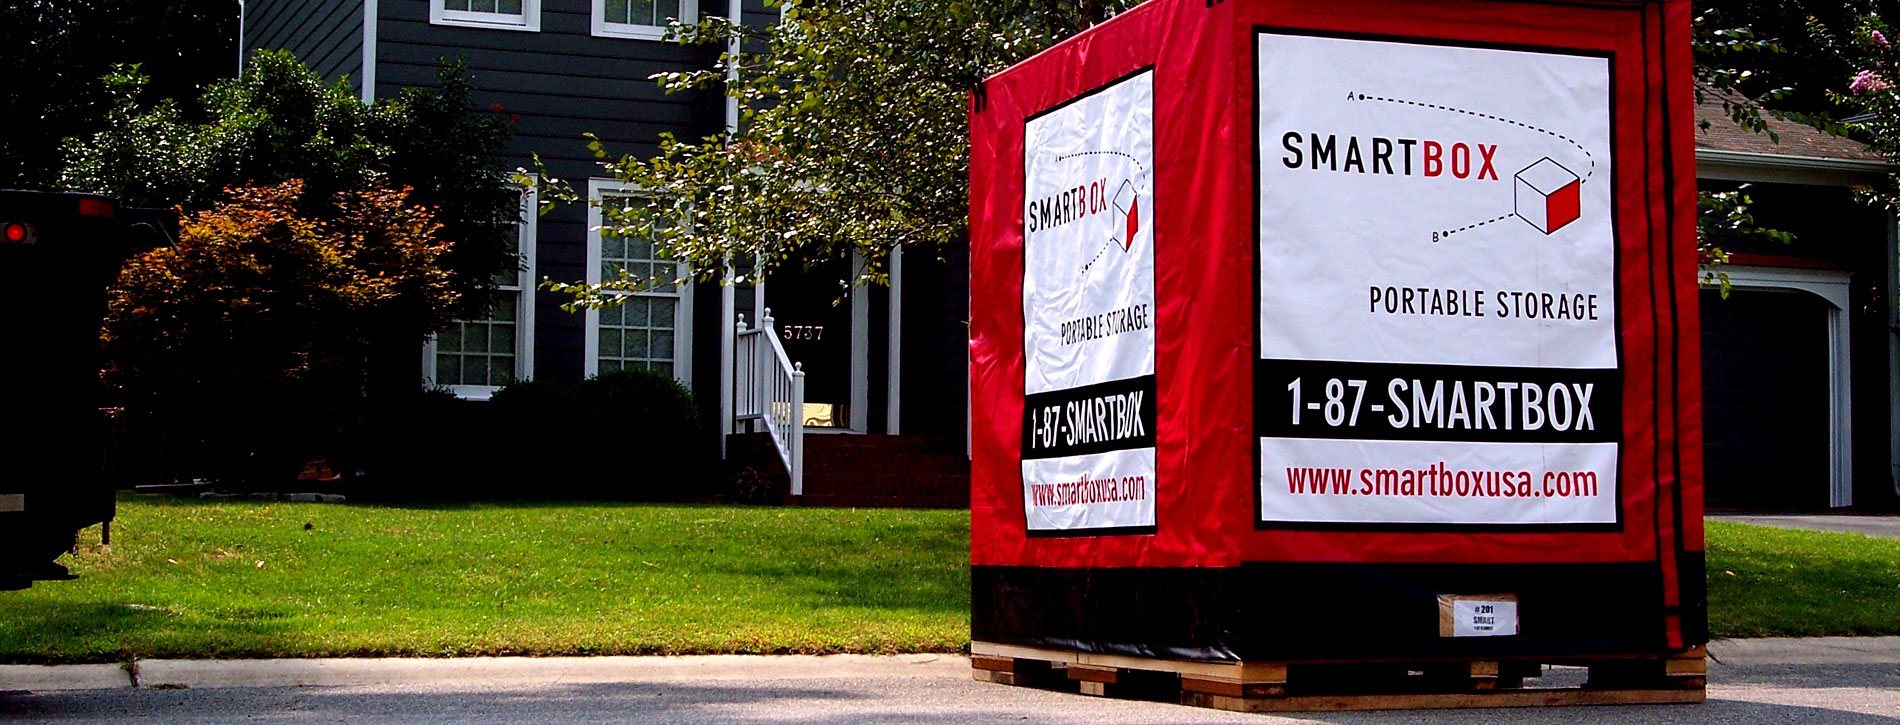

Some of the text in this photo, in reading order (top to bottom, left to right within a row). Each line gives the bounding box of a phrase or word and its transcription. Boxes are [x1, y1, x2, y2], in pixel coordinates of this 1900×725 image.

[1347, 91, 1355, 101] A
[1281, 131, 1499, 181] SMARTBOX
[1029, 177, 1107, 233] SMARTBOX
[1432, 231, 1440, 243] B
[1369, 286, 1599, 321] PORTABLE STORAGE
[784, 325, 824, 340] 5737
[1061, 303, 1149, 346] PORTABLE STORAGE
[1032, 390, 1145, 449] 1-87-SMARTBOX
[1287, 377, 1595, 431] 1-87-SMARTBOX
[1031, 474, 1145, 507] www.smartboxusa.com
[1286, 462, 1598, 498] www.smartboxusa.com
